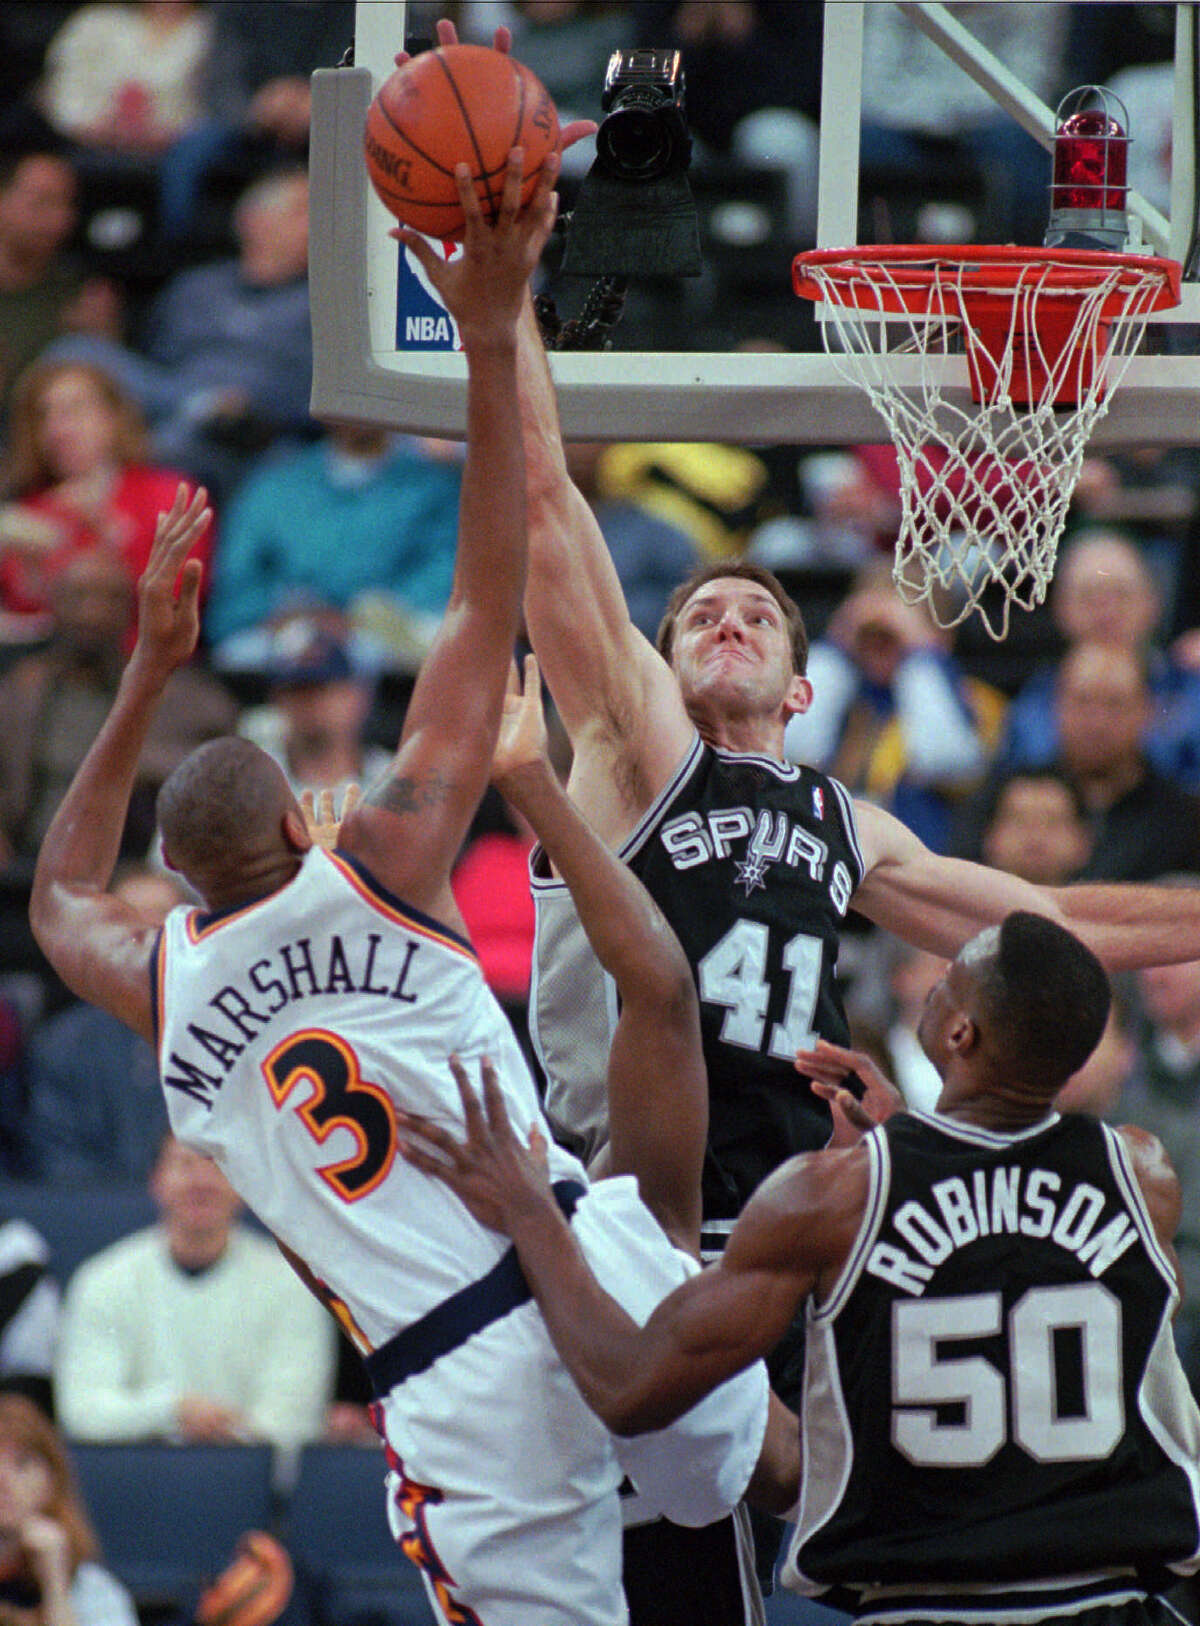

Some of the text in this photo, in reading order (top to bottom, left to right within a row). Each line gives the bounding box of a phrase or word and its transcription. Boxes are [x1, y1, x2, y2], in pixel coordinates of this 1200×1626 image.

[406, 316, 450, 341] NBA
[660, 806, 852, 916] SPURS
[164, 934, 421, 1112] MARSHALL
[698, 918, 824, 1062] 41
[260, 1027, 398, 1205] 3
[867, 1165, 1139, 1297] ROBINSON
[891, 1280, 1126, 1468] 50
